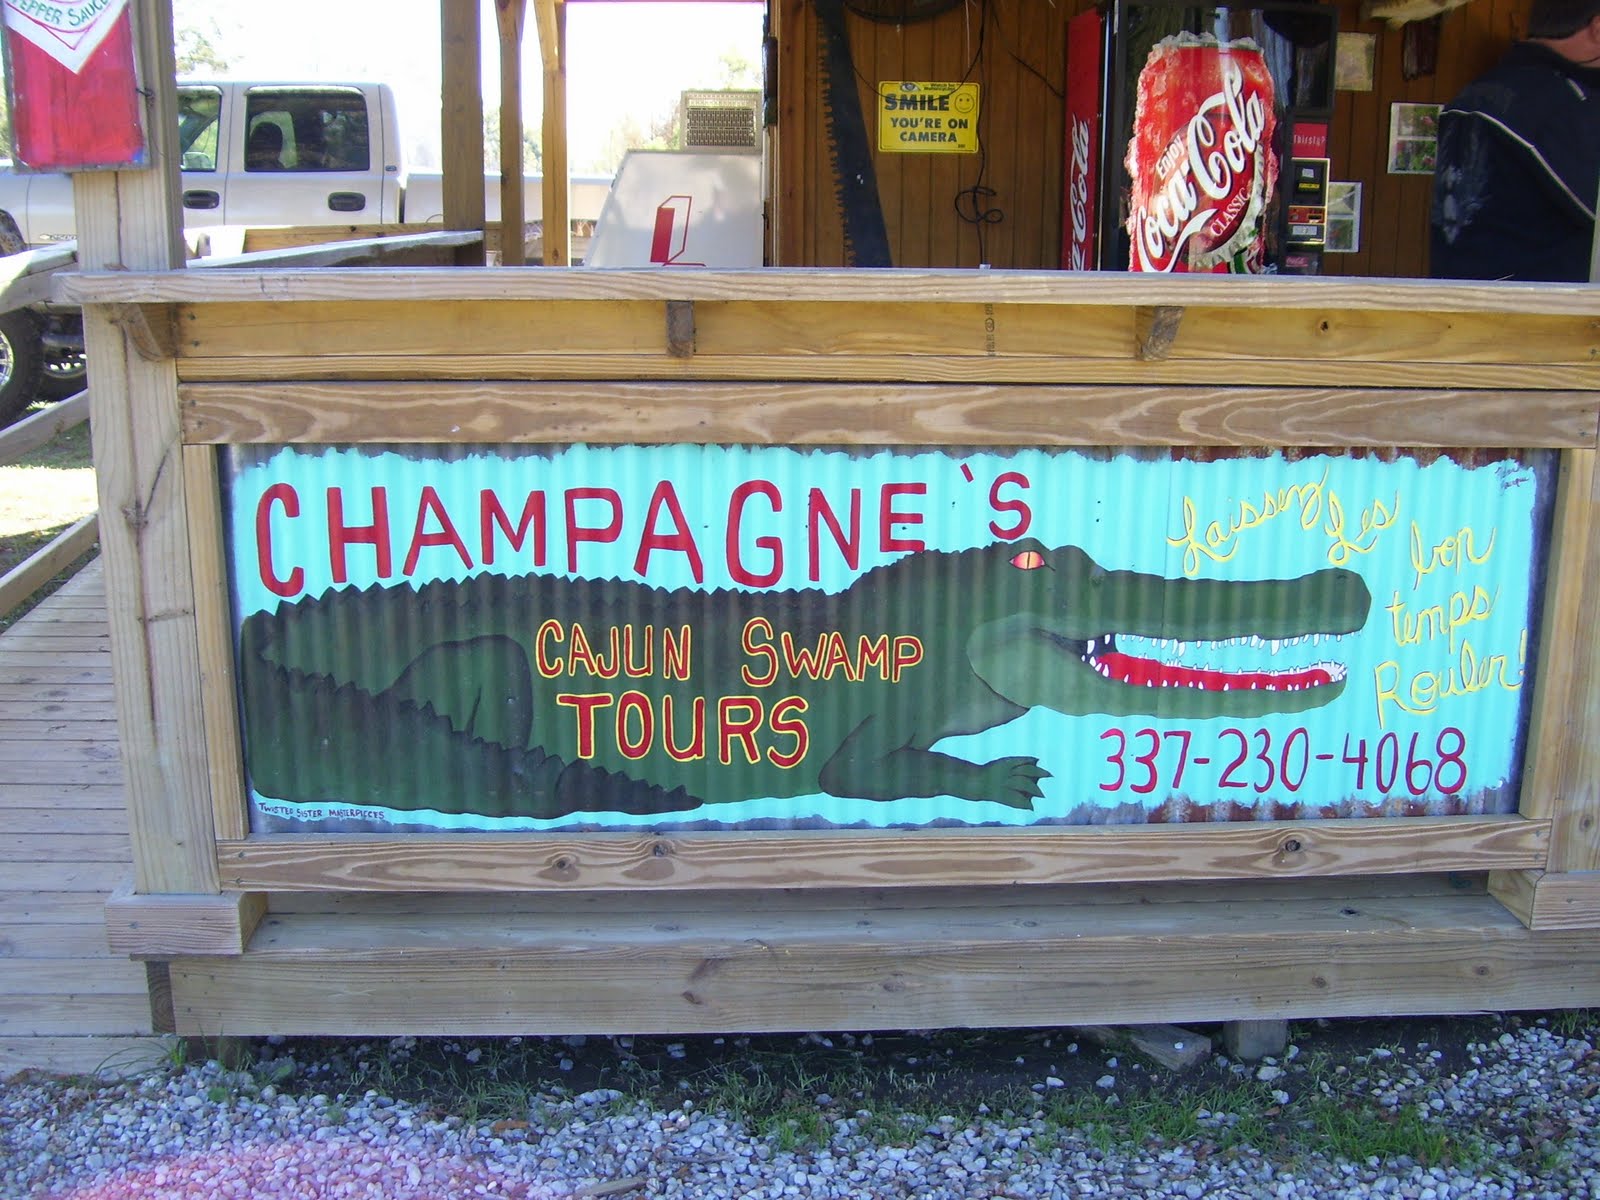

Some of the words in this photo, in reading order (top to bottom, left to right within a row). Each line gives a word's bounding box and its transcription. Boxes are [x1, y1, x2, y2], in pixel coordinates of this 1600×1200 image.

[885, 93, 950, 111] SMILE
[890, 117, 942, 128] YOU'RE
[948, 119, 968, 128] ON
[900, 131, 957, 142] CAMERA
[1155, 134, 1184, 180] Enjoy
[1210, 187, 1250, 236] CLASSIC
[255, 463, 1032, 597] CHAMPAGNE'S
[1385, 584, 1499, 655] temps
[536, 619, 691, 681] CAJUN
[742, 617, 923, 687] SWAMP
[557, 690, 809, 769] TOURS
[1099, 727, 1467, 796] 337-230-4068
[259, 802, 294, 815] TWISTED
[297, 808, 322, 818] SISTER
